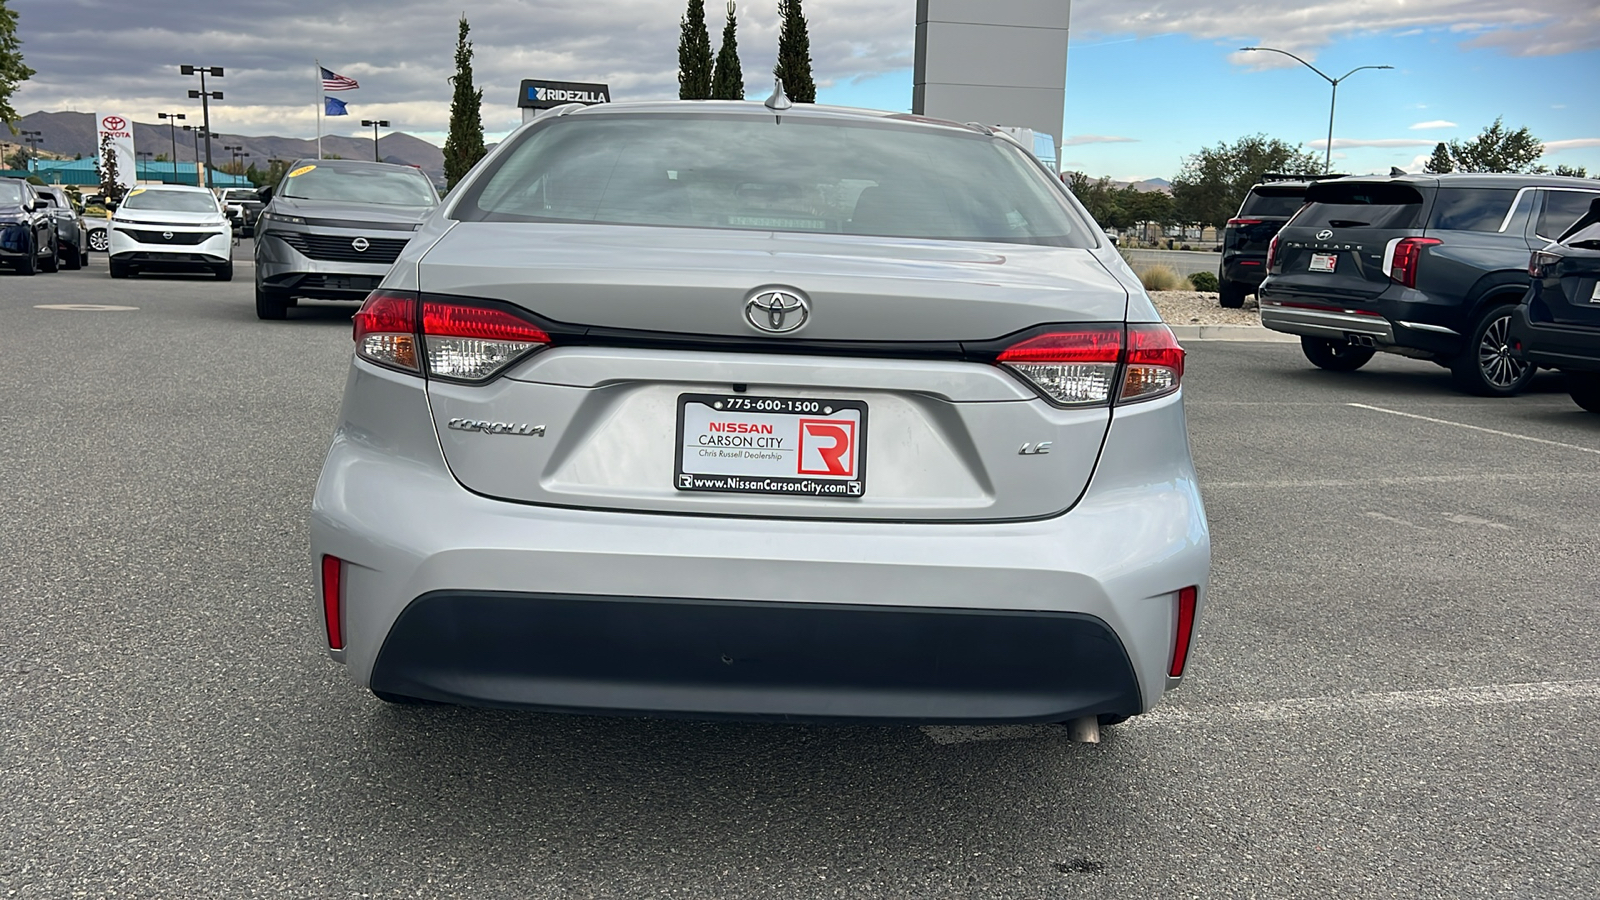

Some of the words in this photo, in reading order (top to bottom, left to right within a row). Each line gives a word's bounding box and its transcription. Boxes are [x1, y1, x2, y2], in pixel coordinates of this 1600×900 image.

[547, 89, 606, 103] RIDEZILLA
[1287, 242, 1363, 250] PALISADE
[727, 398, 819, 413] 775-600-1500
[448, 417, 547, 437] COROLLA
[709, 422, 773, 434] NISSAN
[698, 434, 753, 447] CARSON
[756, 437, 784, 448] CITY
[1018, 441, 1053, 455] LE
[698, 449, 717, 458] Chris
[719, 450, 743, 459] Russell
[744, 451, 782, 461] Dealership
[694, 477, 847, 495] www.NissanCarsonCity.com
